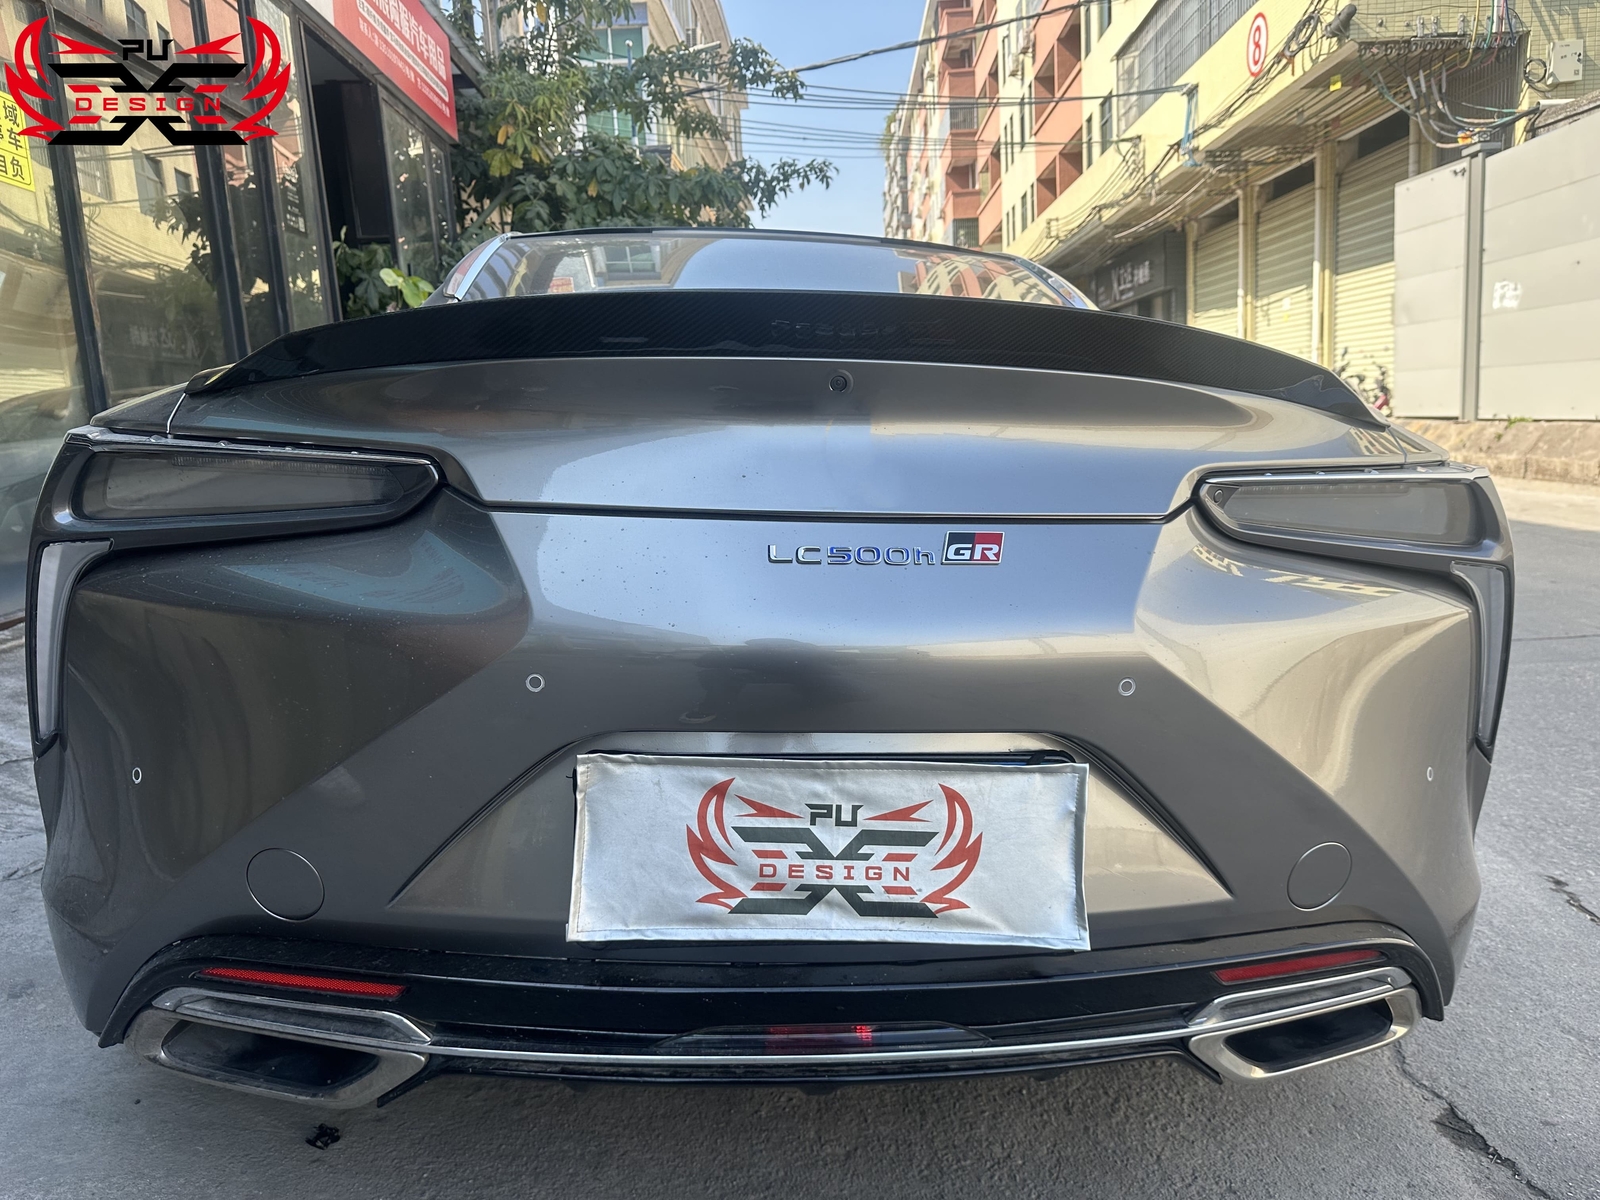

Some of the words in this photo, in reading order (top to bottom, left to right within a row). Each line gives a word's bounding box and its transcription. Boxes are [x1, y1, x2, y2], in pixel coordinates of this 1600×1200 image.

[1252, 24, 1262, 67] 8
[944, 541, 1001, 563] GR
[804, 803, 865, 828] PU
[758, 863, 912, 882] DESIGN
